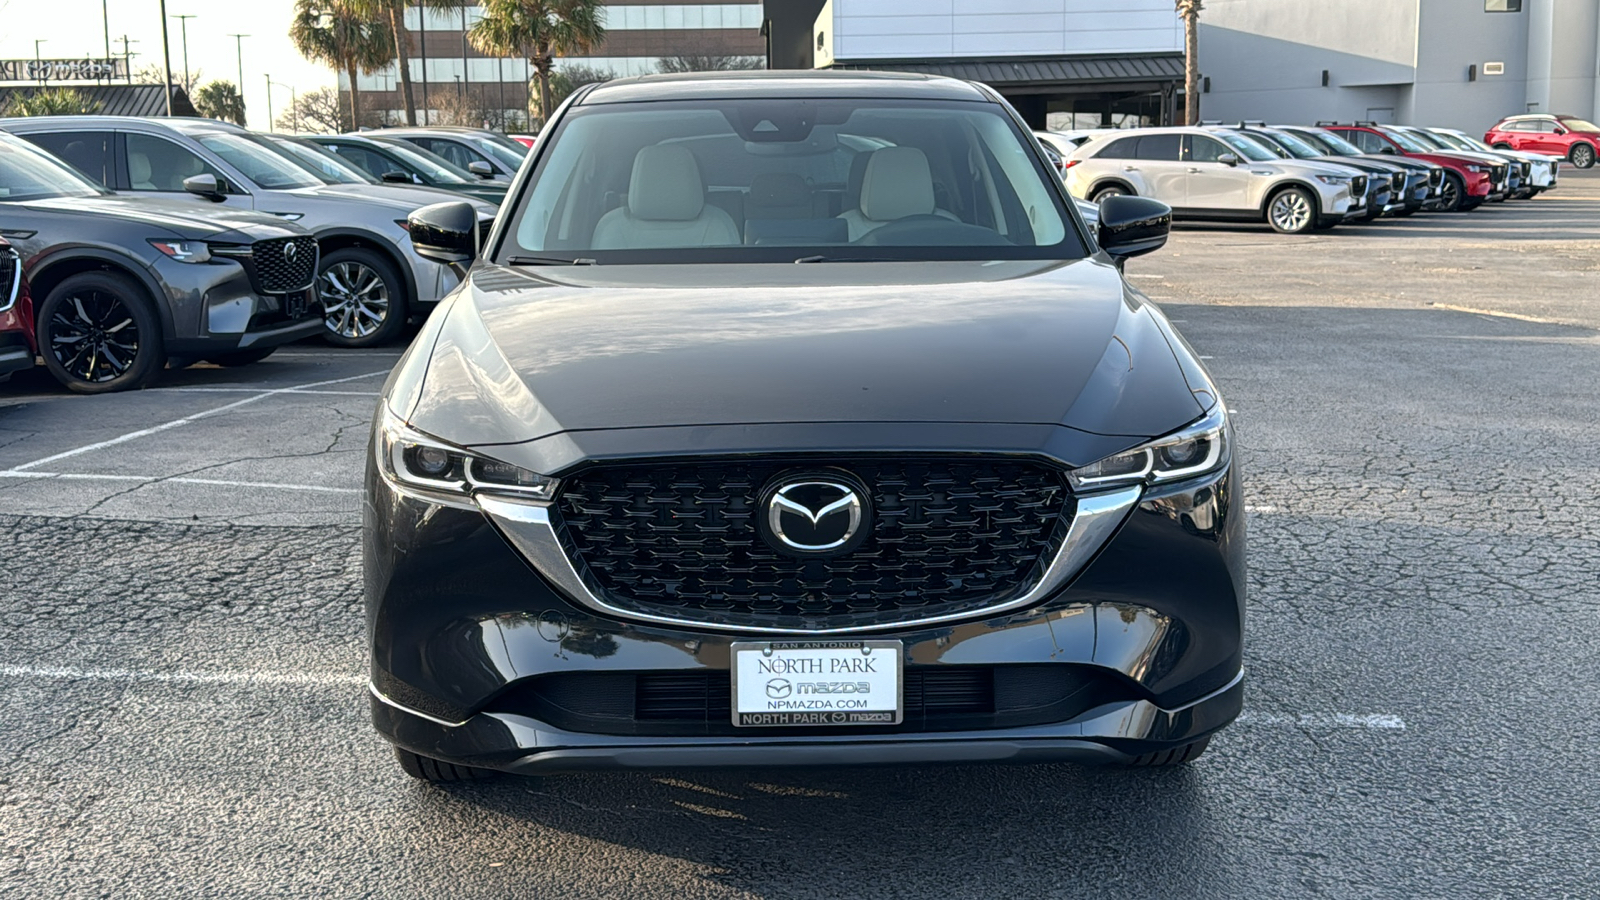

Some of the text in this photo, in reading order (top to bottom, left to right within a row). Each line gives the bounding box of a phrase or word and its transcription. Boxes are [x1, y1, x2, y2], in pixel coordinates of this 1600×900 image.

[803, 641, 862, 649] ANTONIO
[758, 657, 877, 674] NORTH PARK
[796, 681, 871, 695] mazda
[767, 699, 868, 710] NPMAZDA.COM
[742, 712, 892, 725] NORTH PARK mazda
